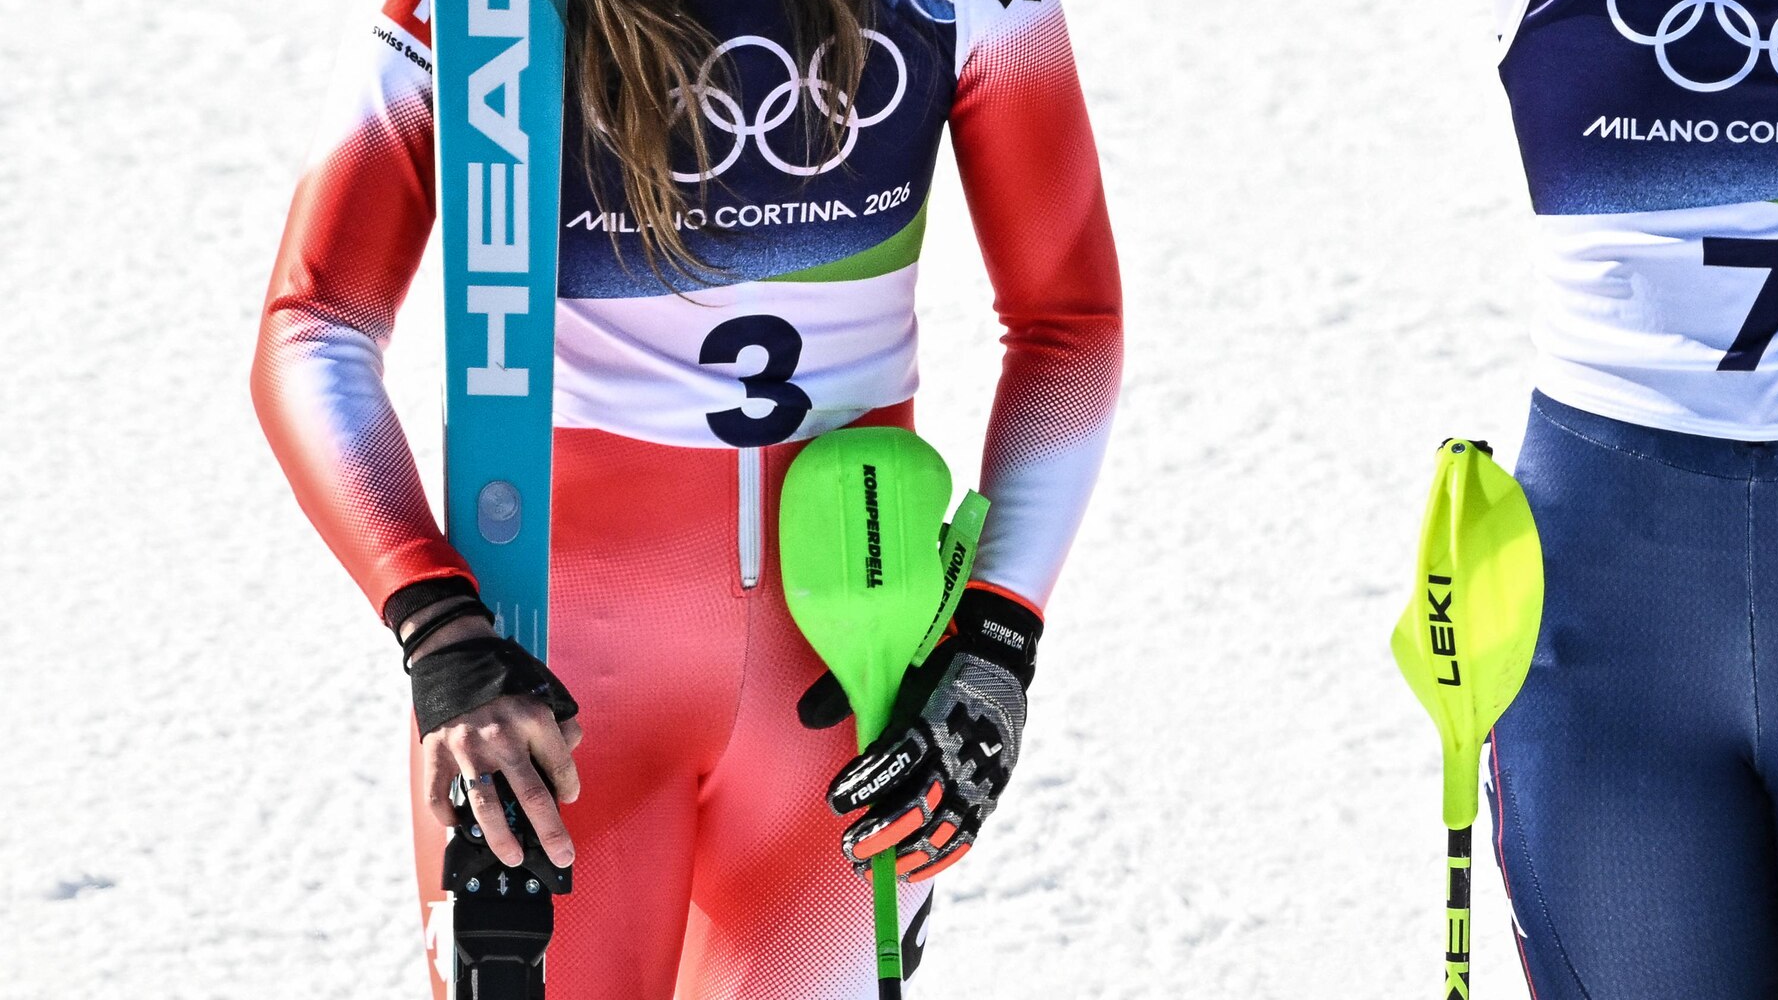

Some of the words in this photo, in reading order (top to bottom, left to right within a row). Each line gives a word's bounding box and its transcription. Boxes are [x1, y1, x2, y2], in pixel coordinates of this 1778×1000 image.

[372, 25, 403, 51] swiss
[1582, 115, 1719, 142] MILANO
[715, 199, 857, 229] CORTINA
[863, 181, 911, 216] 2026
[699, 314, 812, 447] 3
[863, 463, 883, 588] KOMPERDELL
[983, 619, 1024, 645] WARRIOR
[1428, 574, 1461, 687] LEKI
[850, 752, 911, 805] reusch
